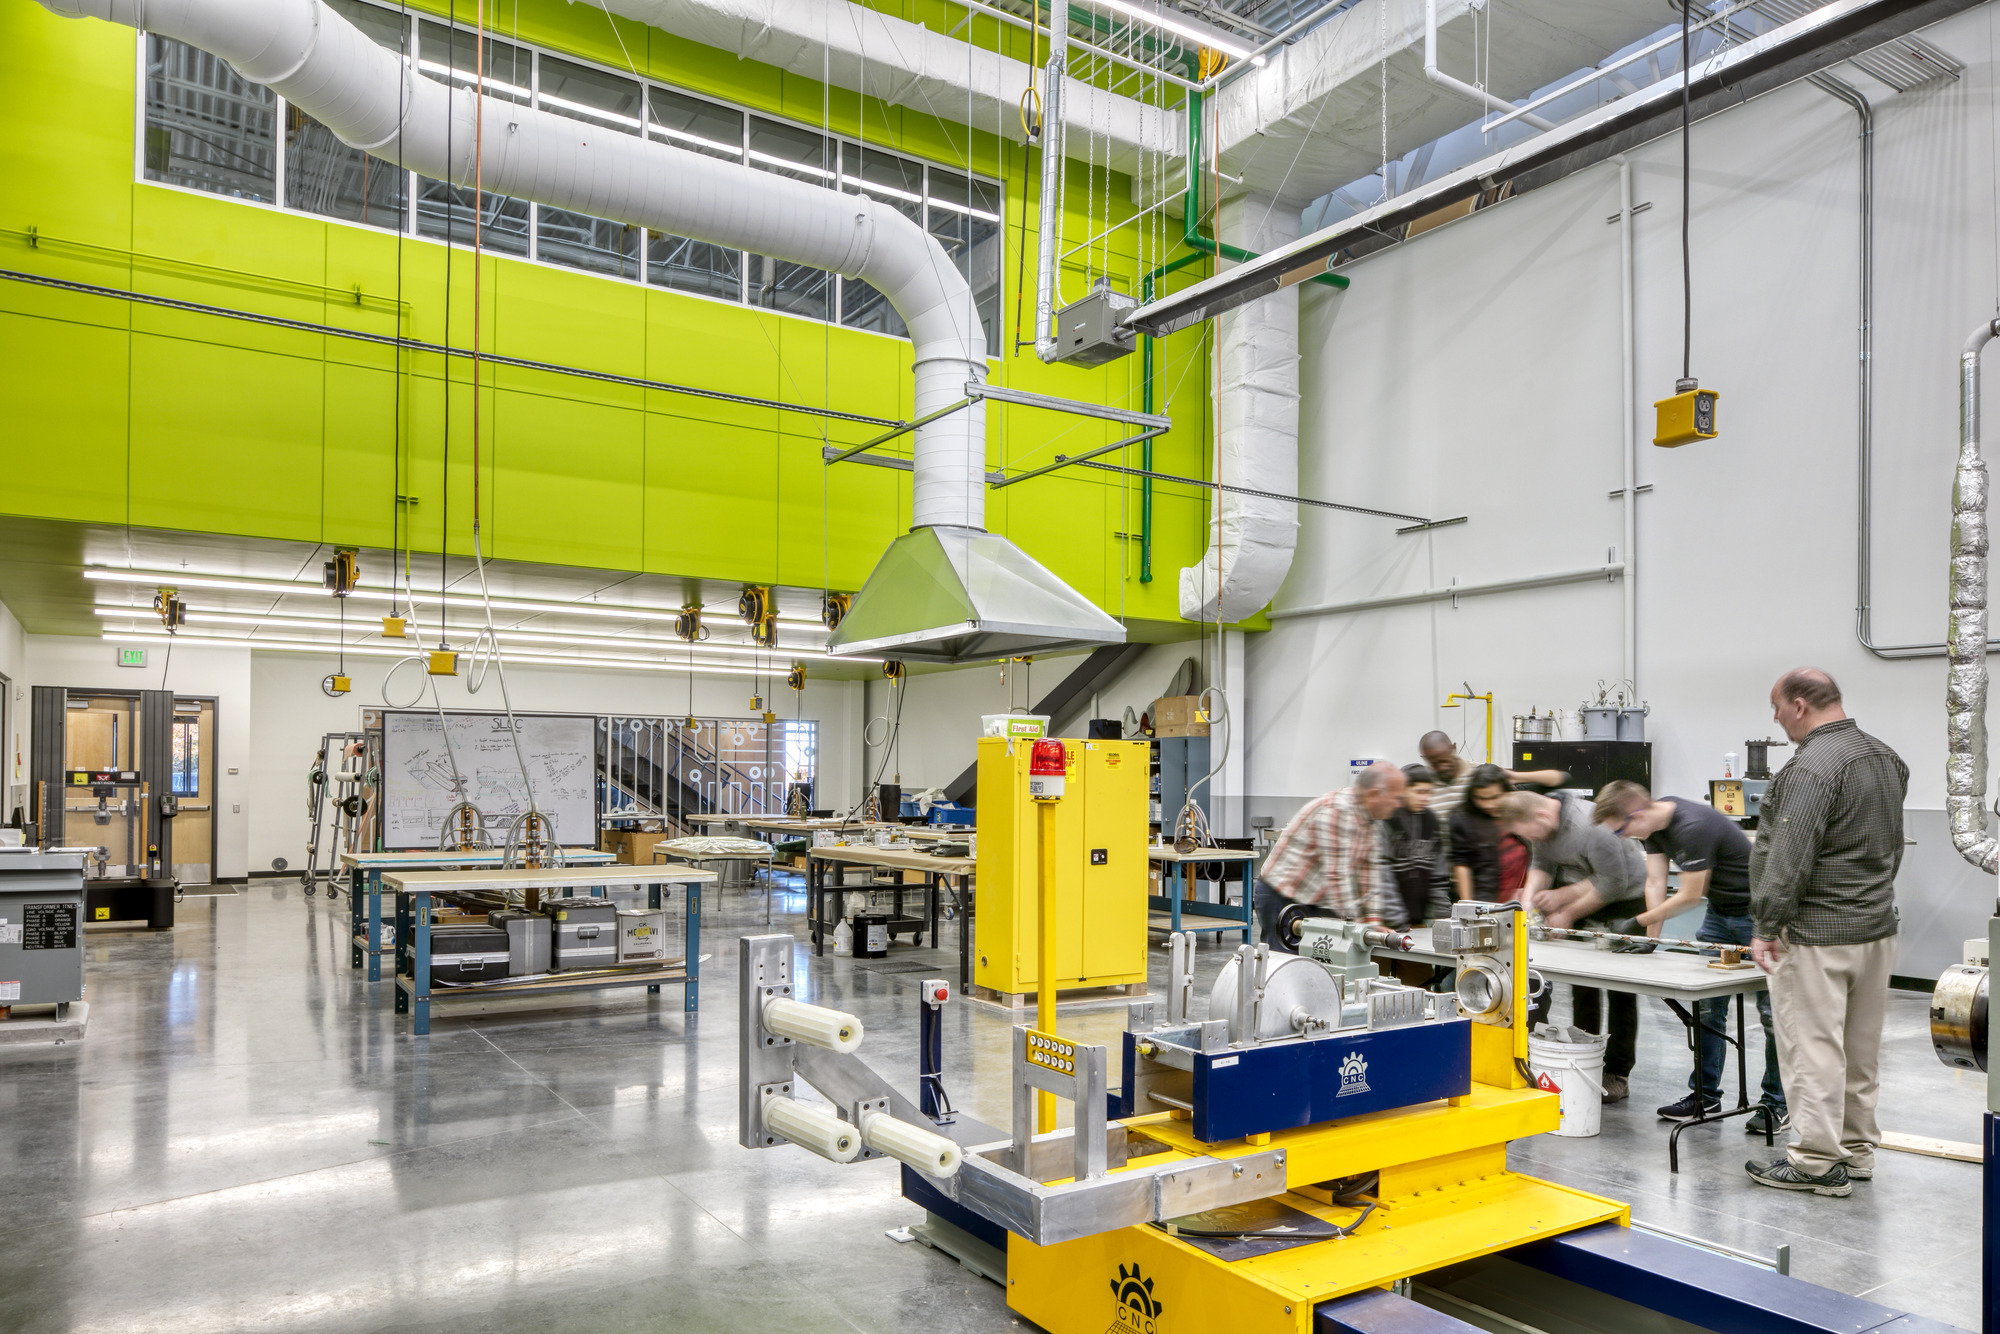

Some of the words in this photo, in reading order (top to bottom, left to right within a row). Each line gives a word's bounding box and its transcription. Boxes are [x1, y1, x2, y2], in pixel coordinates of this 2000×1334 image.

[124, 650, 143, 664] EXIT
[1343, 1074, 1364, 1084] CNC
[1118, 1306, 1154, 1334] CNC
